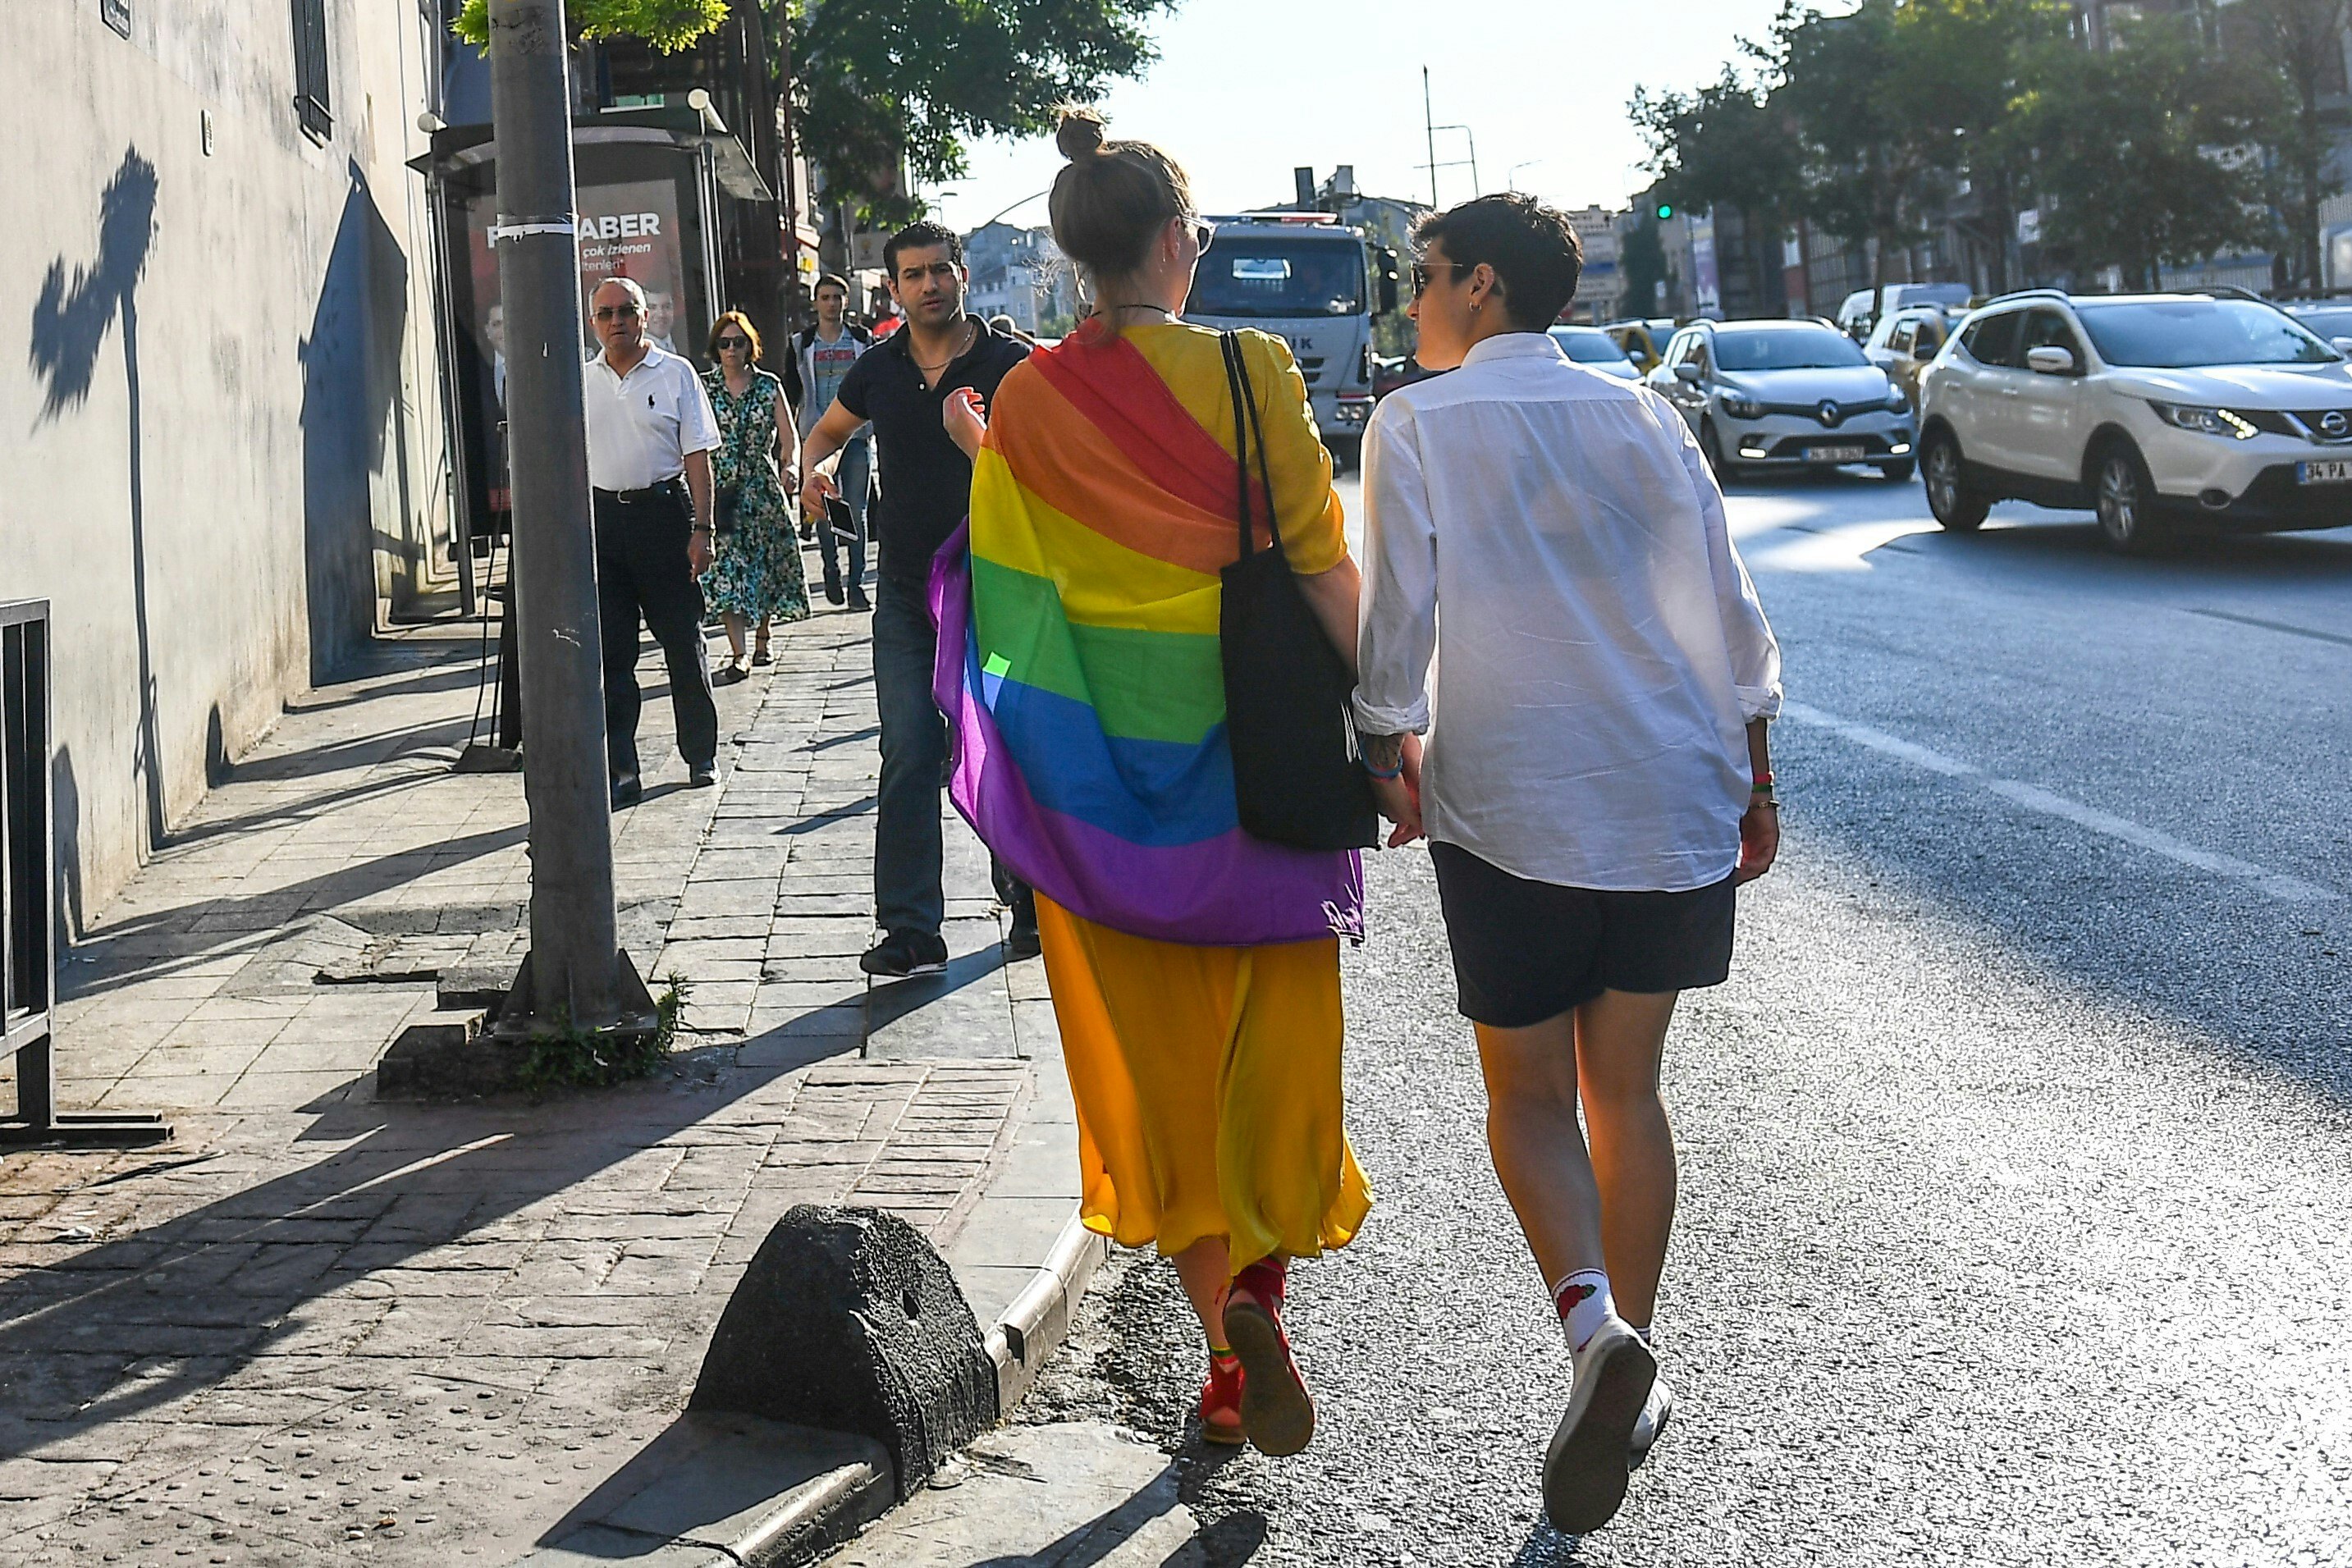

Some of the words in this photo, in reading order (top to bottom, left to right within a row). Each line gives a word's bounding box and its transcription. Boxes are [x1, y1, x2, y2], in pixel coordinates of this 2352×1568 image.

[579, 213, 661, 240] ABER
[583, 245, 605, 258] çok
[607, 243, 652, 256] izlenen
